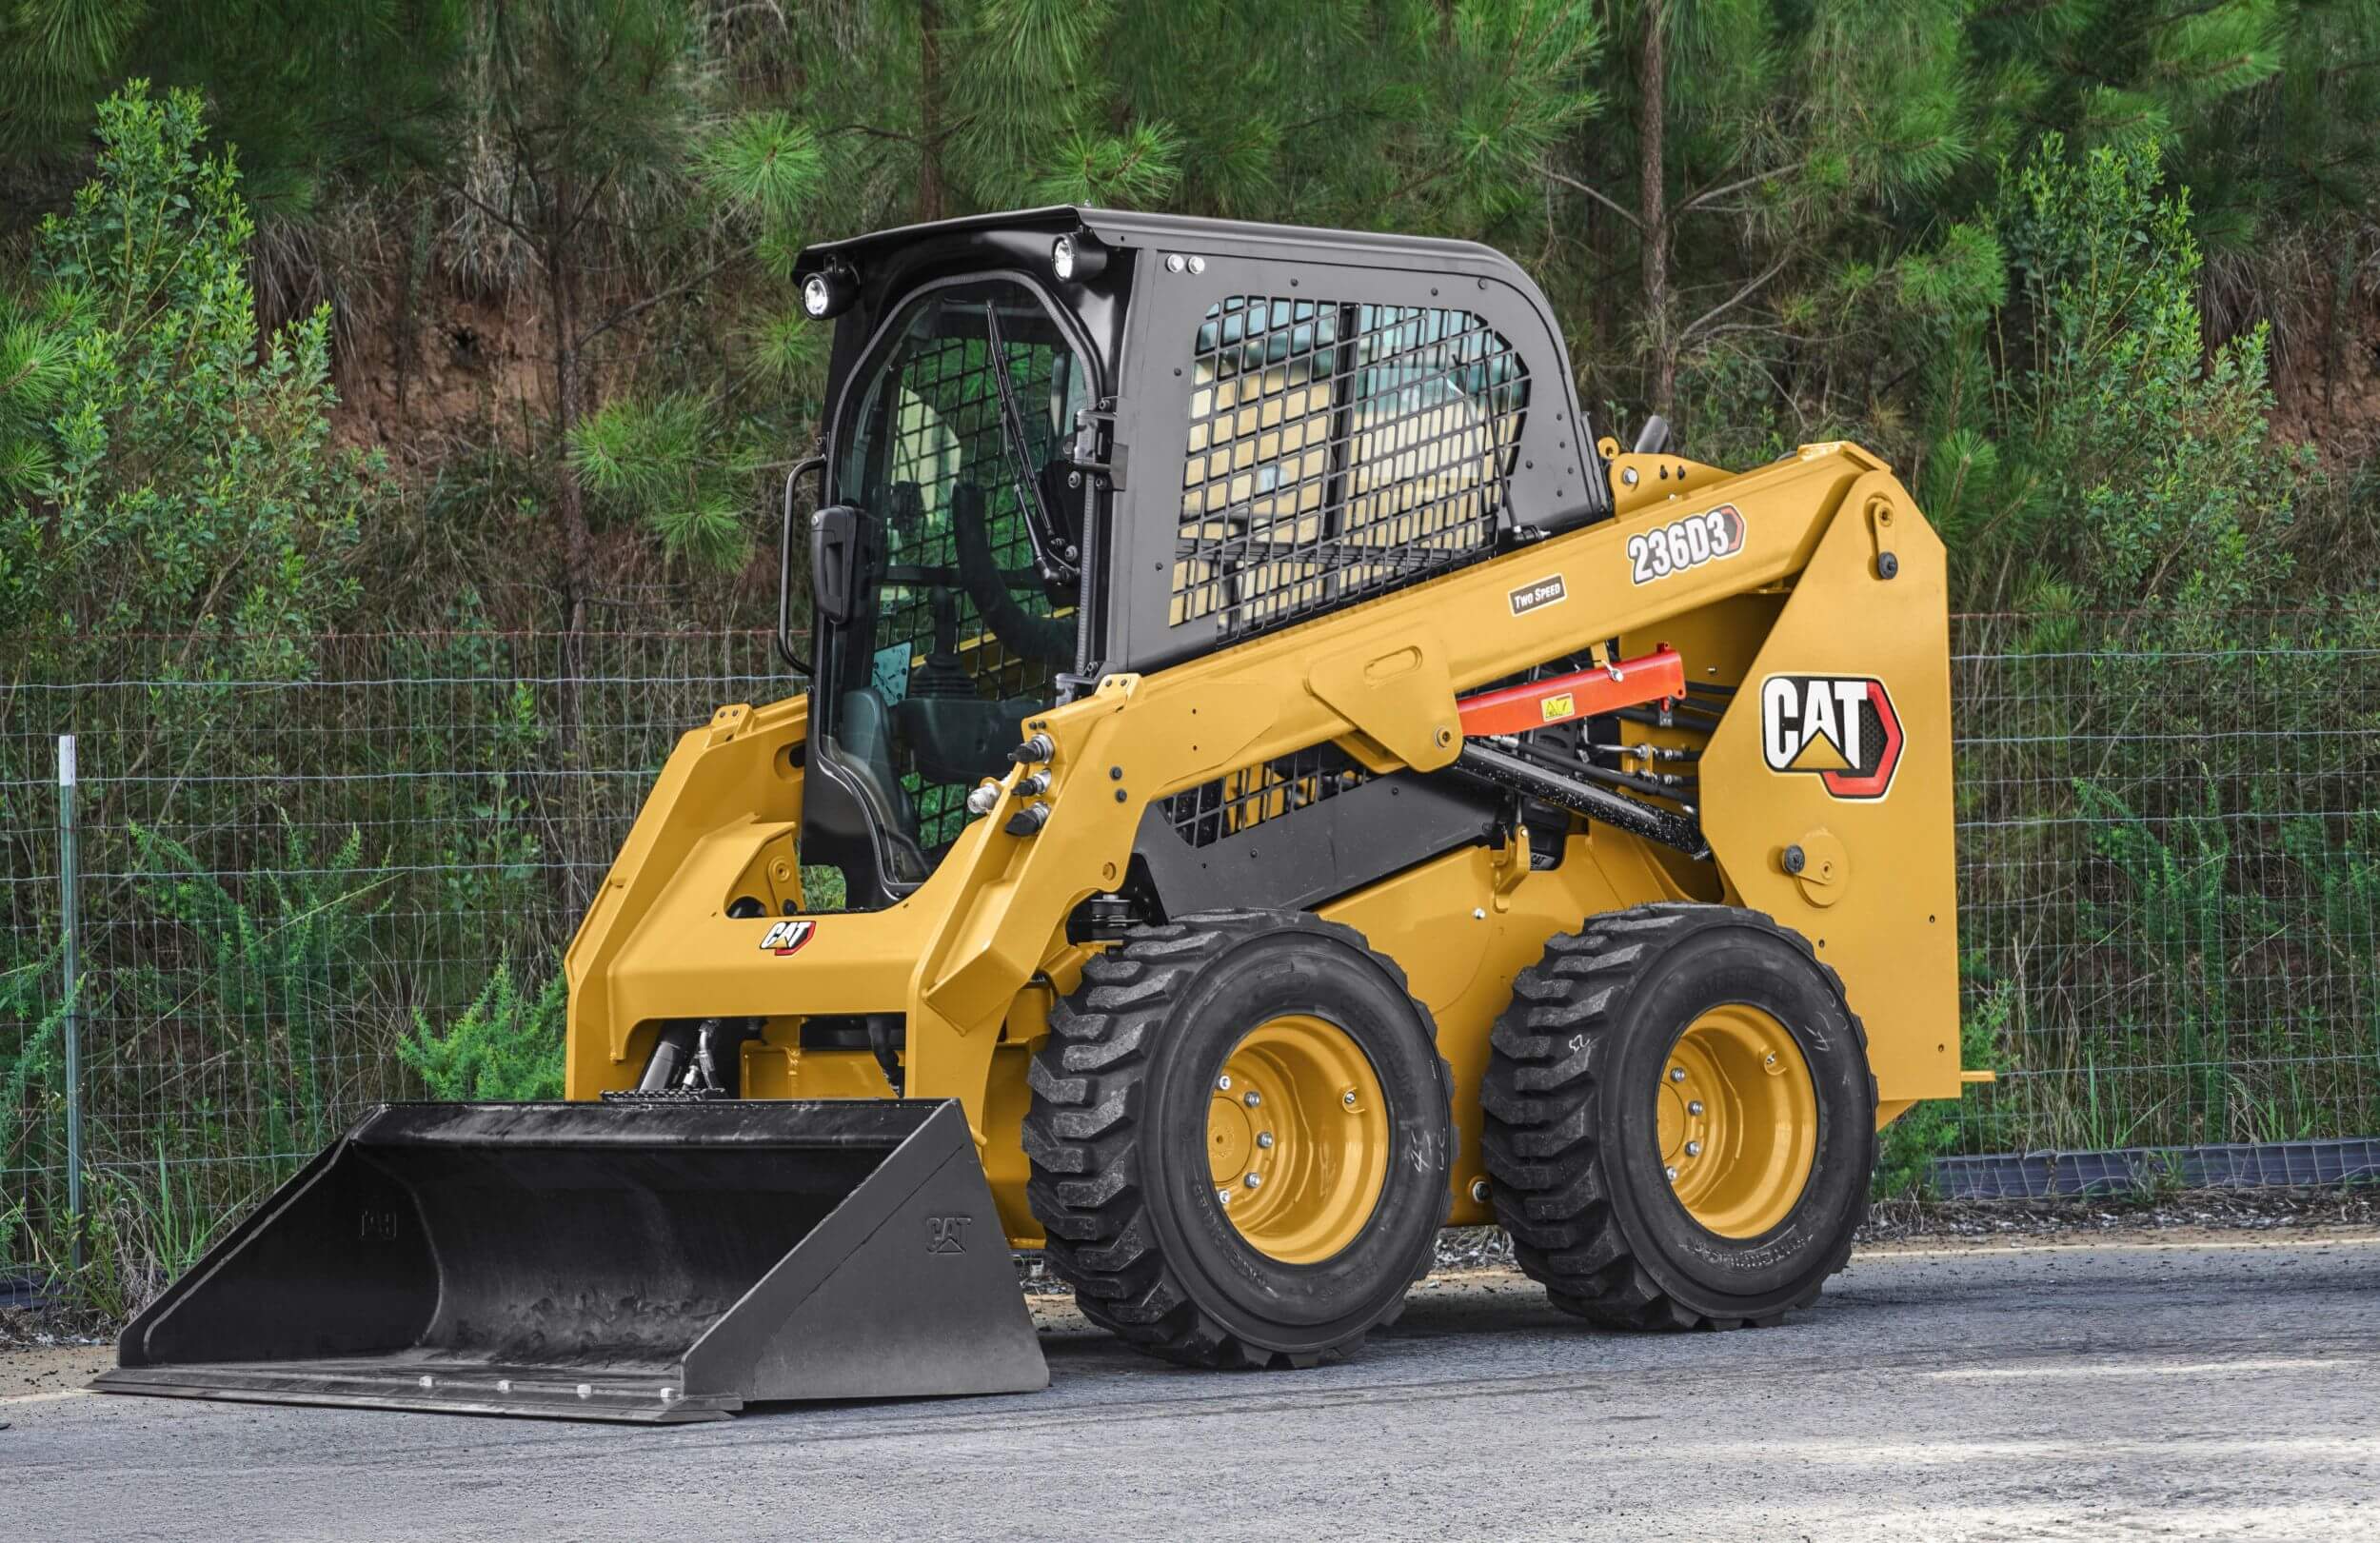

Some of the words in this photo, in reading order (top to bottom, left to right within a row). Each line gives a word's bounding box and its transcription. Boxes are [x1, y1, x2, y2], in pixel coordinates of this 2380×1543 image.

[1629, 511, 1729, 583] 236D3
[1763, 678, 1868, 769] CAT
[761, 921, 812, 949] CAT
[925, 1217, 972, 1255] CAT
